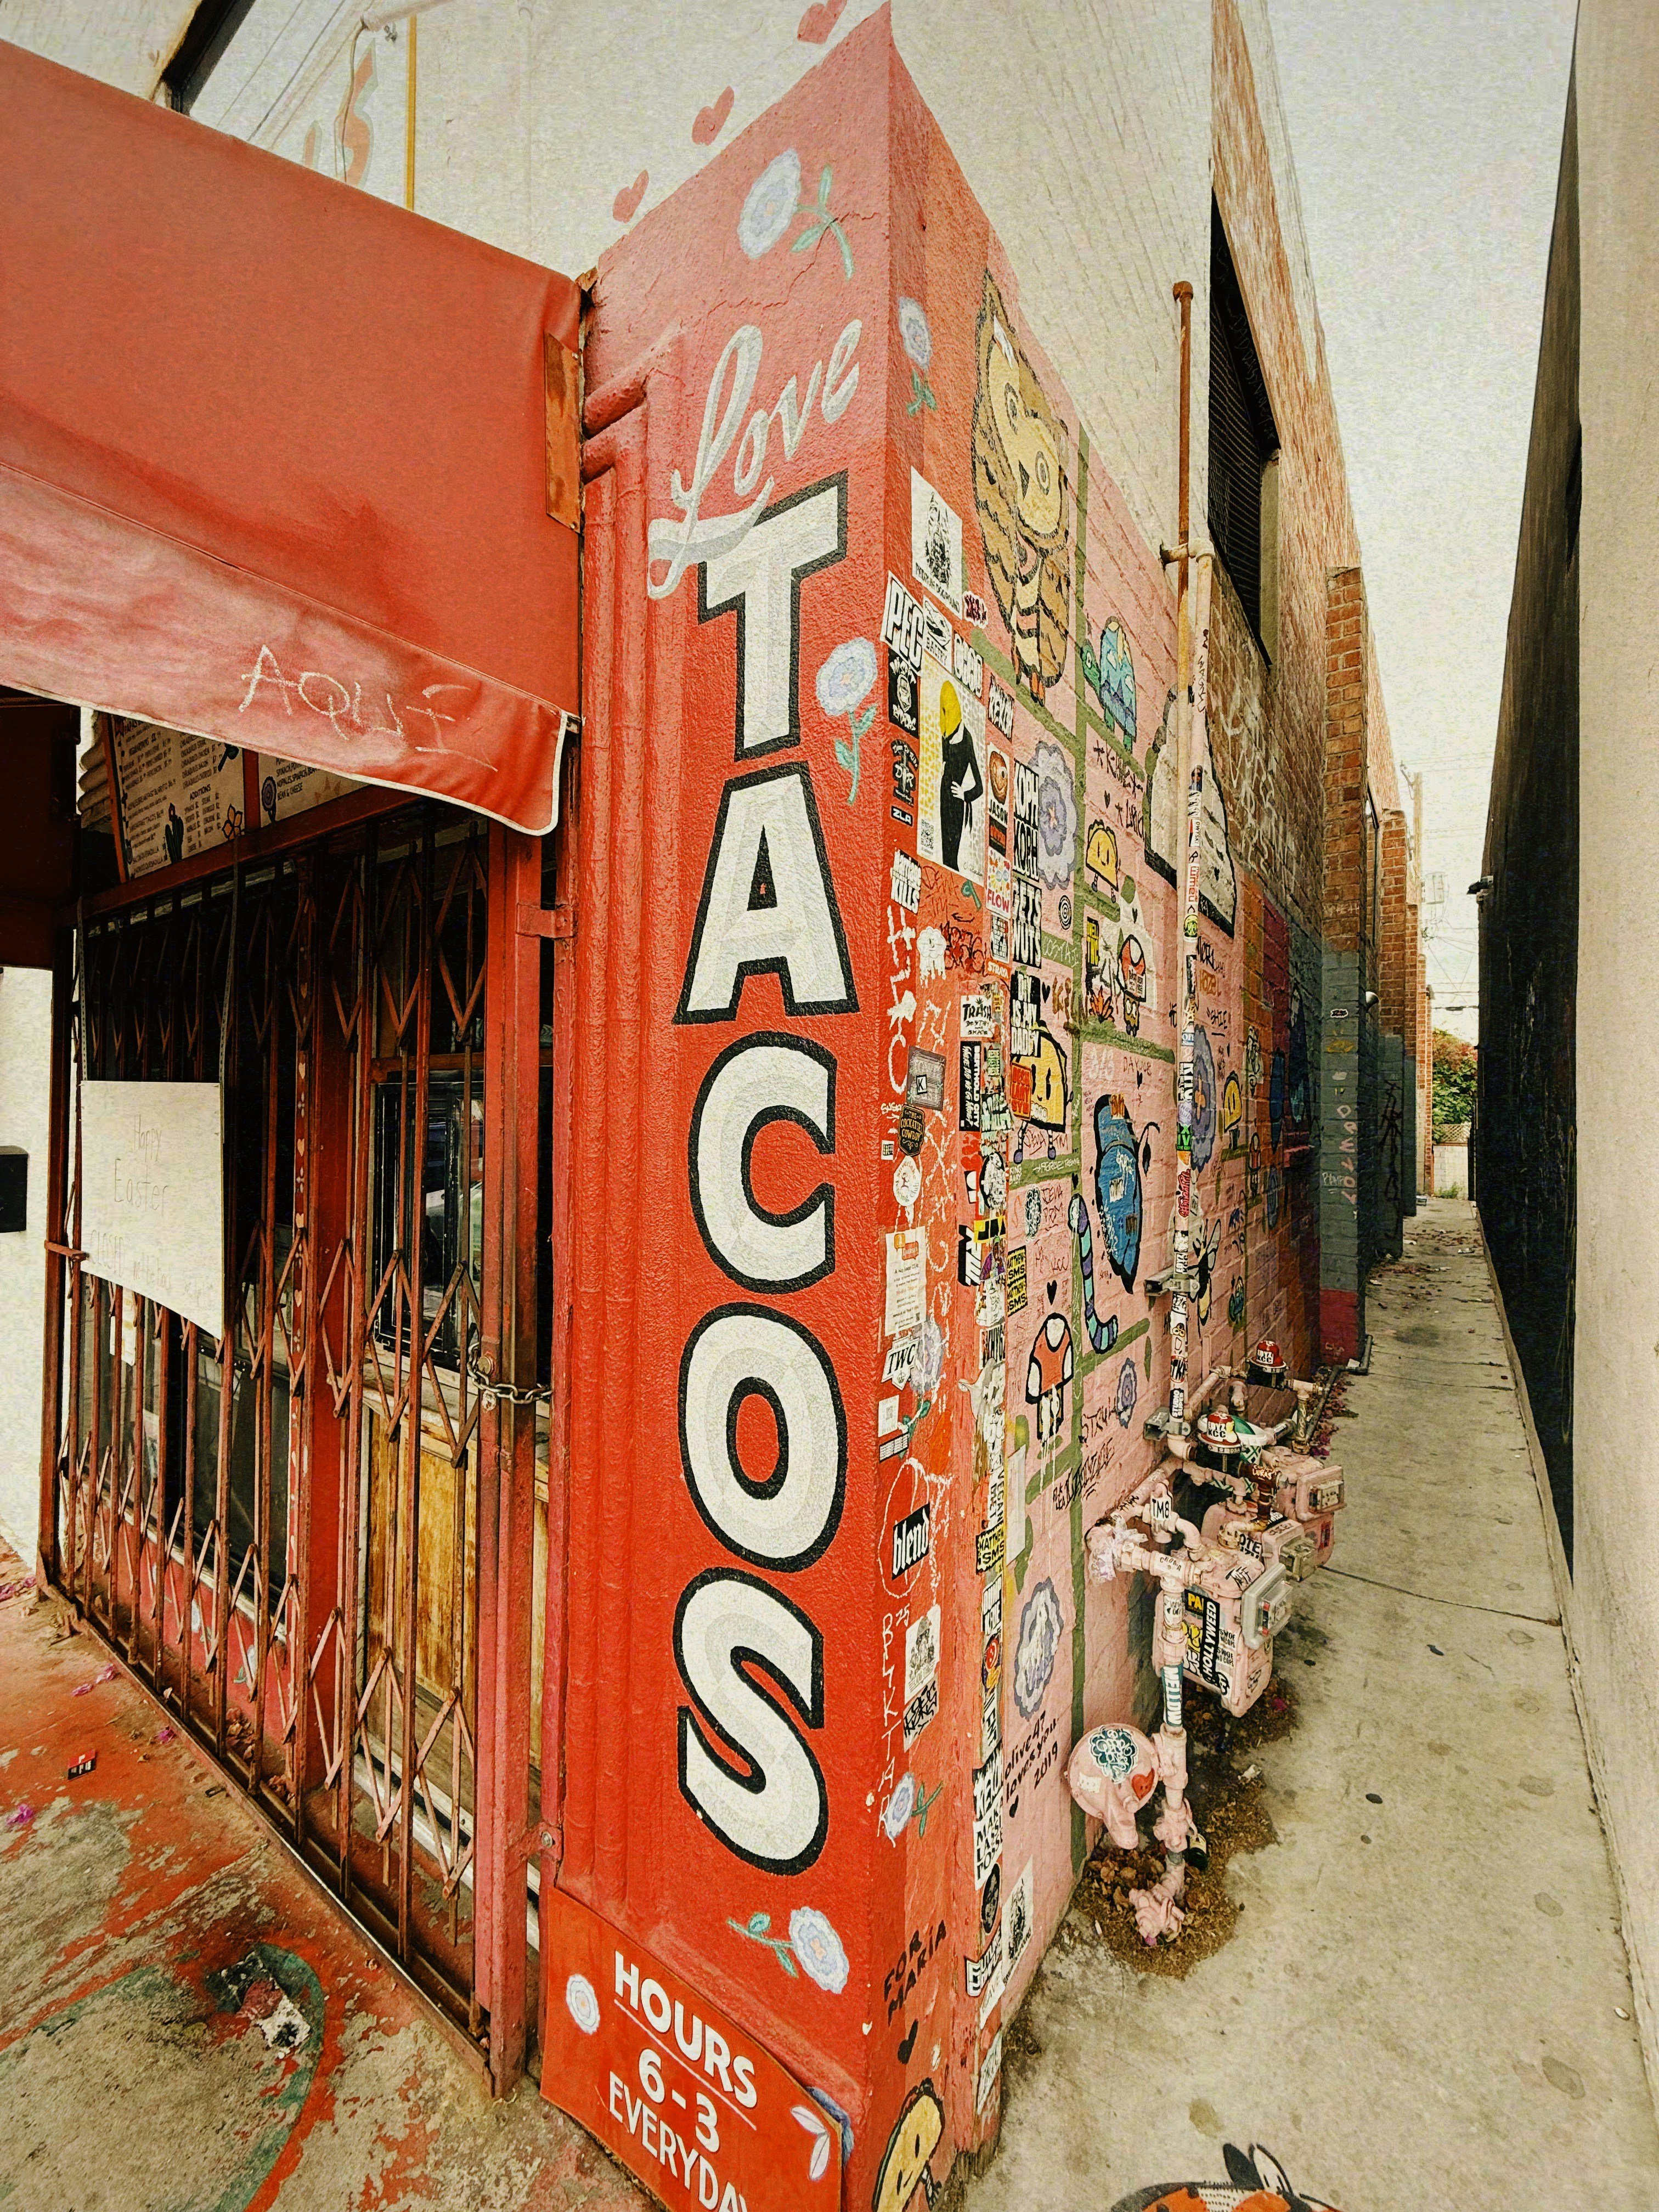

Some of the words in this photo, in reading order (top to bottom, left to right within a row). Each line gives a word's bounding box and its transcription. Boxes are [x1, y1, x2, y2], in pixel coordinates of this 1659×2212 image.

[190, 784, 211, 800] ADDITIONS
[893, 808, 912, 824] ZLA
[987, 889, 1009, 913] FLOW
[962, 1003, 991, 1022] TRASH
[909, 1111, 917, 1119] THE
[133, 1114, 162, 1162] Happy
[902, 1128, 921, 1141] COWBOY
[114, 1158, 168, 1212] Easter
[673, 470, 860, 1876] TACOS
[887, 1344, 915, 1376] TWC
[1208, 1429, 1226, 1438] KCC
[893, 1508, 929, 1576] blend
[1237, 1533, 1262, 1555] OTE
[1203, 1600, 1217, 1675] HOLLYWEED
[614, 1949, 758, 2109] HOURS
[609, 2071, 747, 2212] EVERYDA
